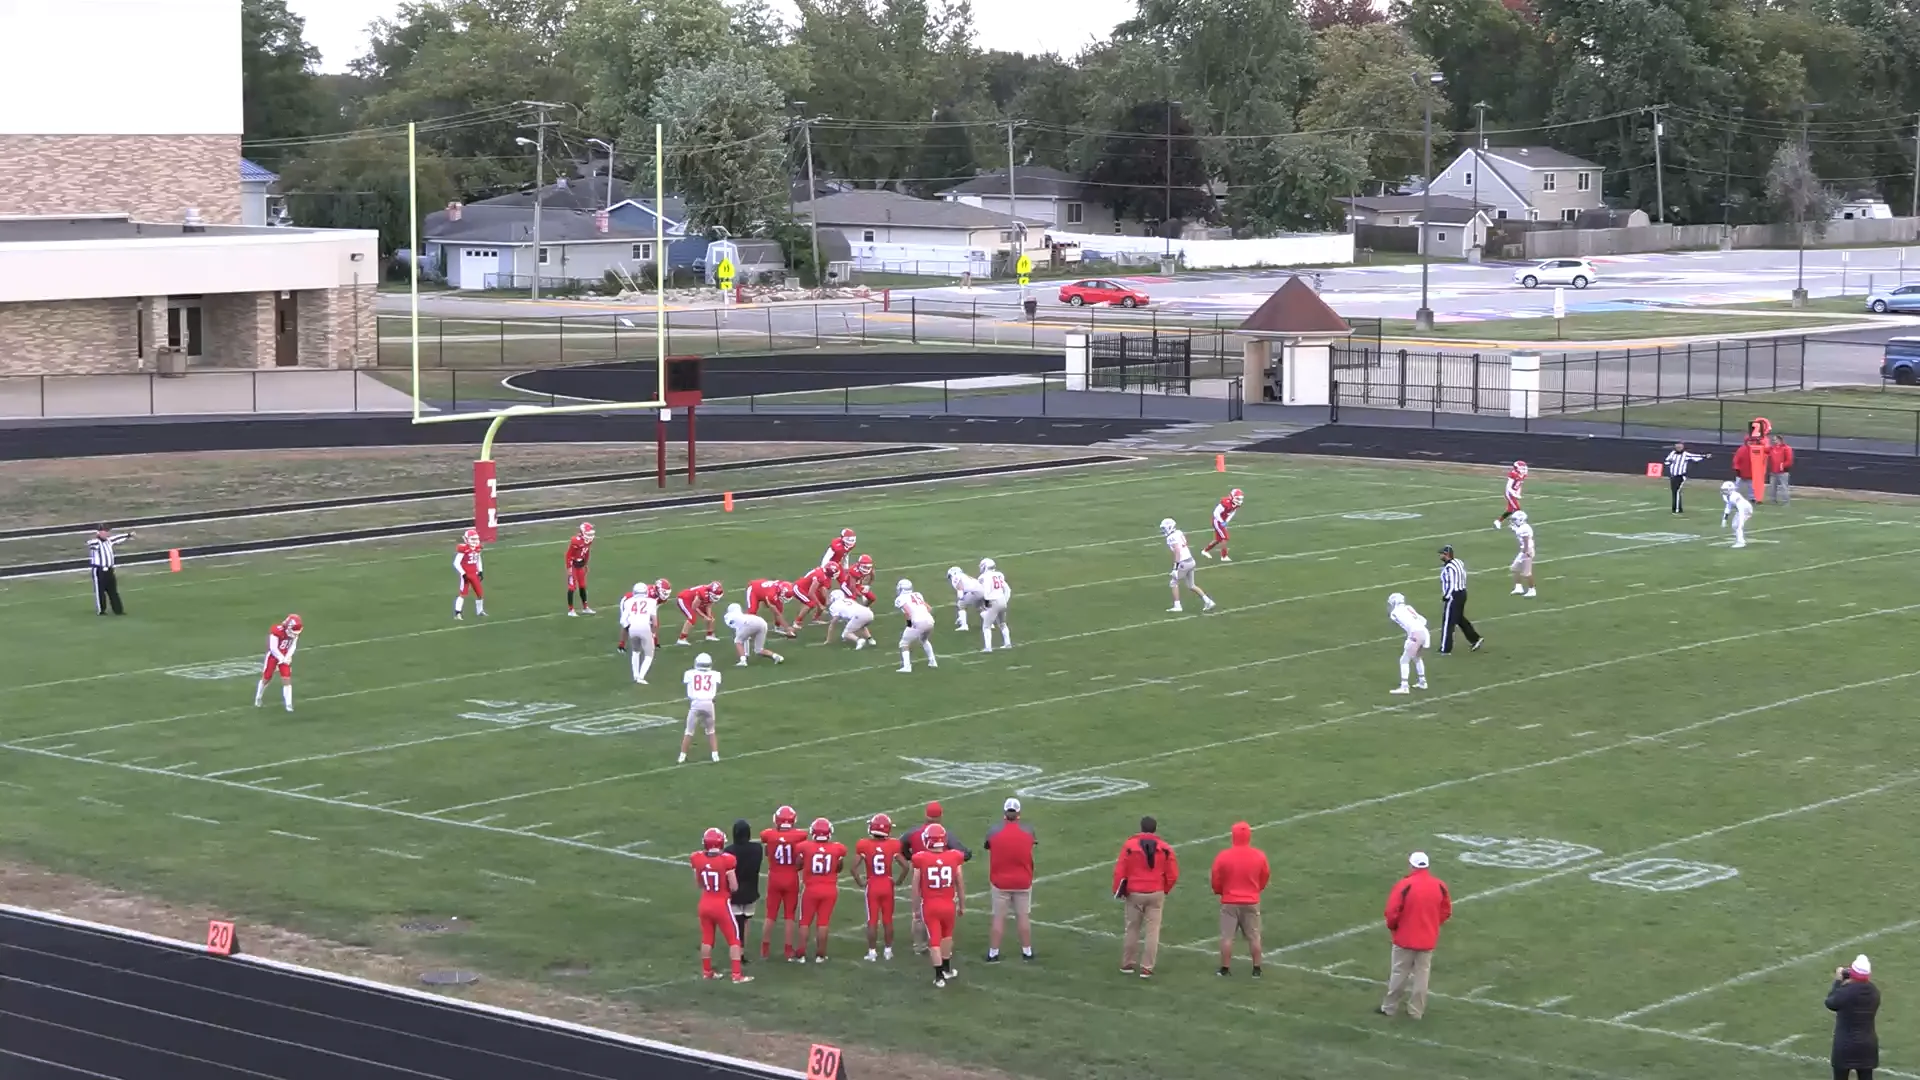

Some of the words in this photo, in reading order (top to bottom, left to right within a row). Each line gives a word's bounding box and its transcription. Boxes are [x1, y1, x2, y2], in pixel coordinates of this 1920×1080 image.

[1751, 422, 1761, 437] 2
[631, 600, 648, 615] 42
[693, 674, 712, 692] 83
[774, 844, 793, 865] 41
[812, 853, 832, 874] 61
[873, 853, 885, 875] 6
[701, 870, 719, 891] 17
[927, 865, 953, 888] 59
[211, 924, 229, 948] 20
[811, 1047, 836, 1078] 30
